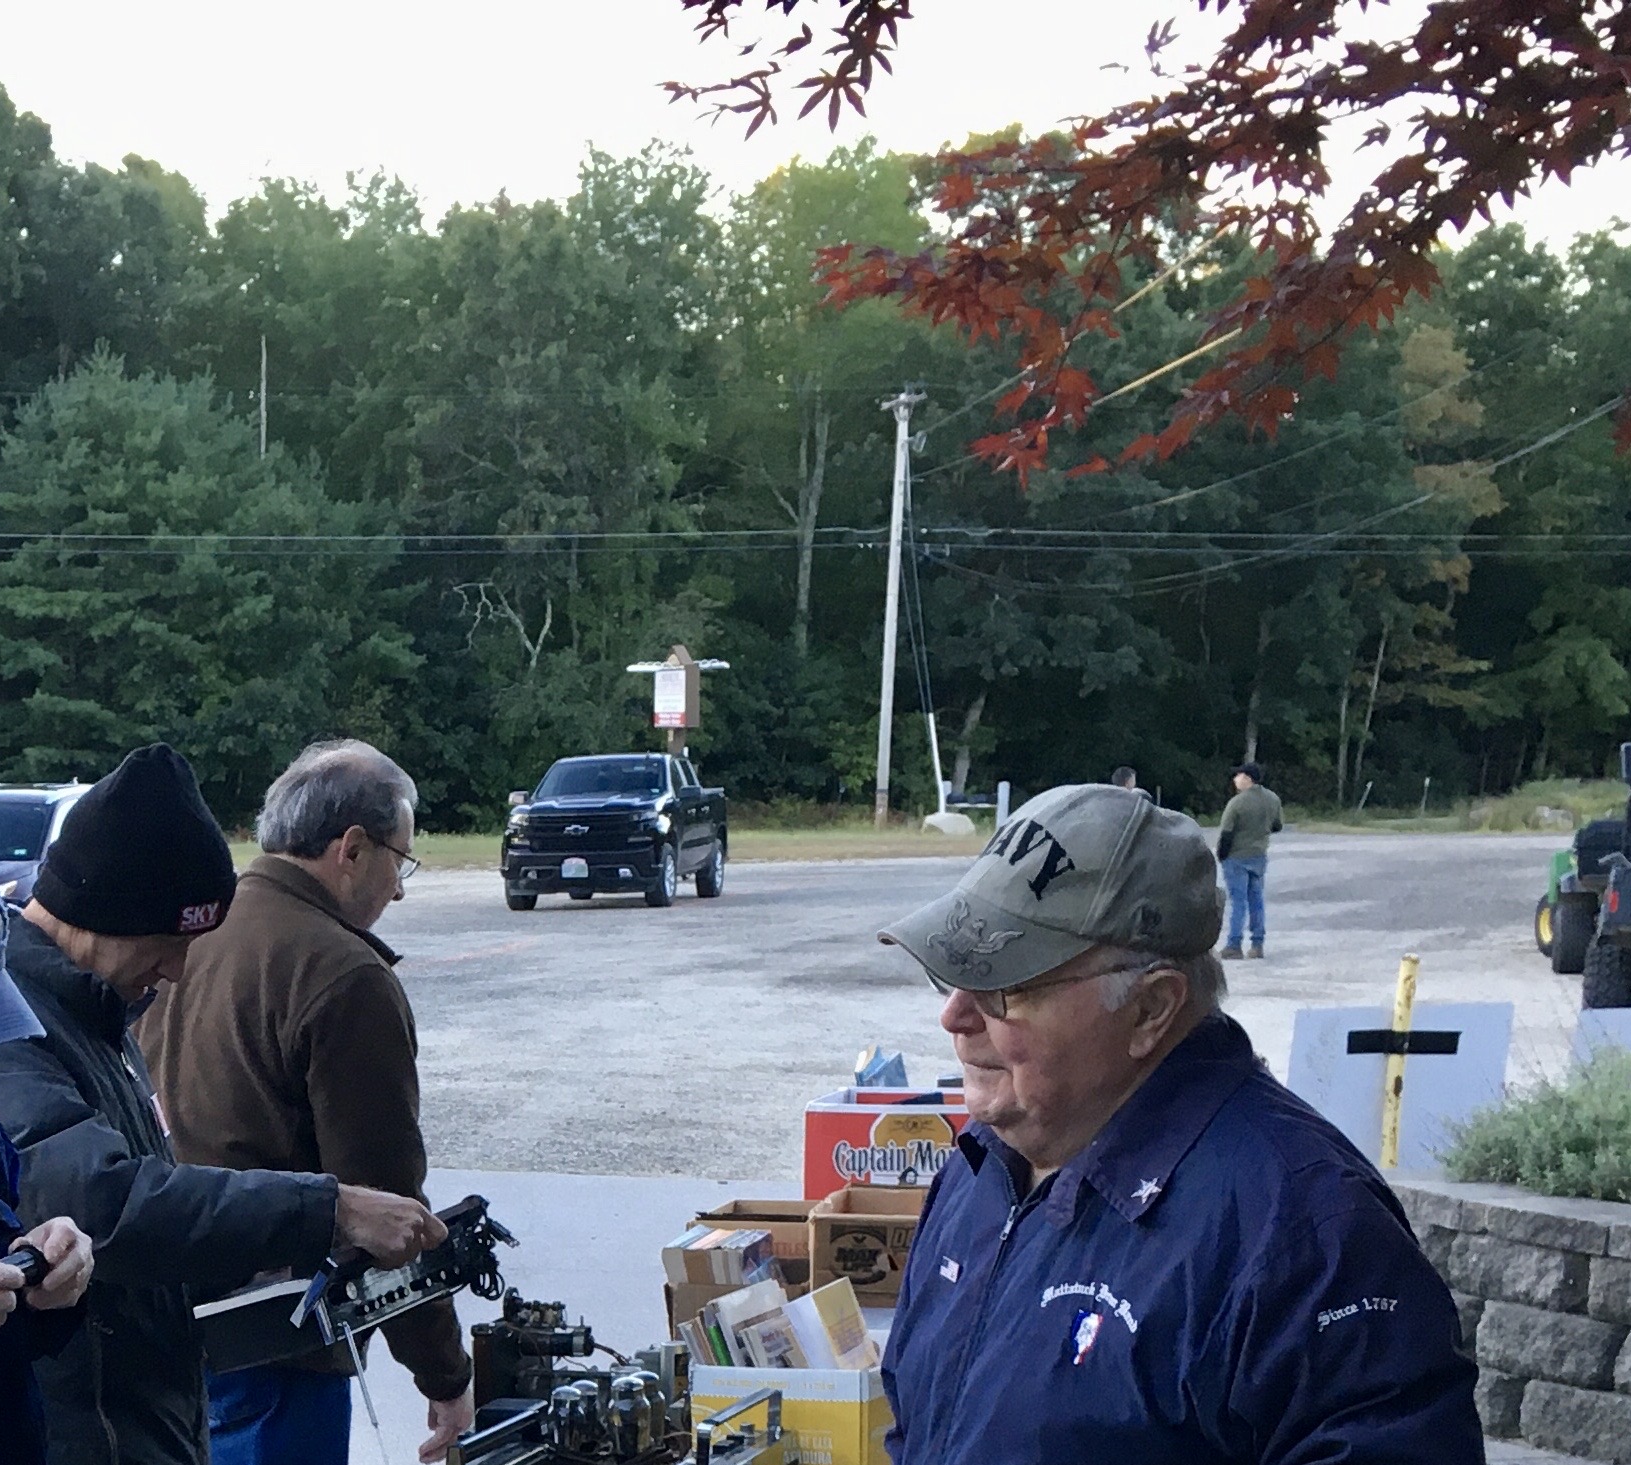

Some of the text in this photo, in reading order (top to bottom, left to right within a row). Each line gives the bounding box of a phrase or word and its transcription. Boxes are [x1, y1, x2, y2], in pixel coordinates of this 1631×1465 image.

[181, 902, 219, 925] SKY
[834, 1140, 952, 1177] Captain Mo
[1317, 1297, 1398, 1332] Since 1767
